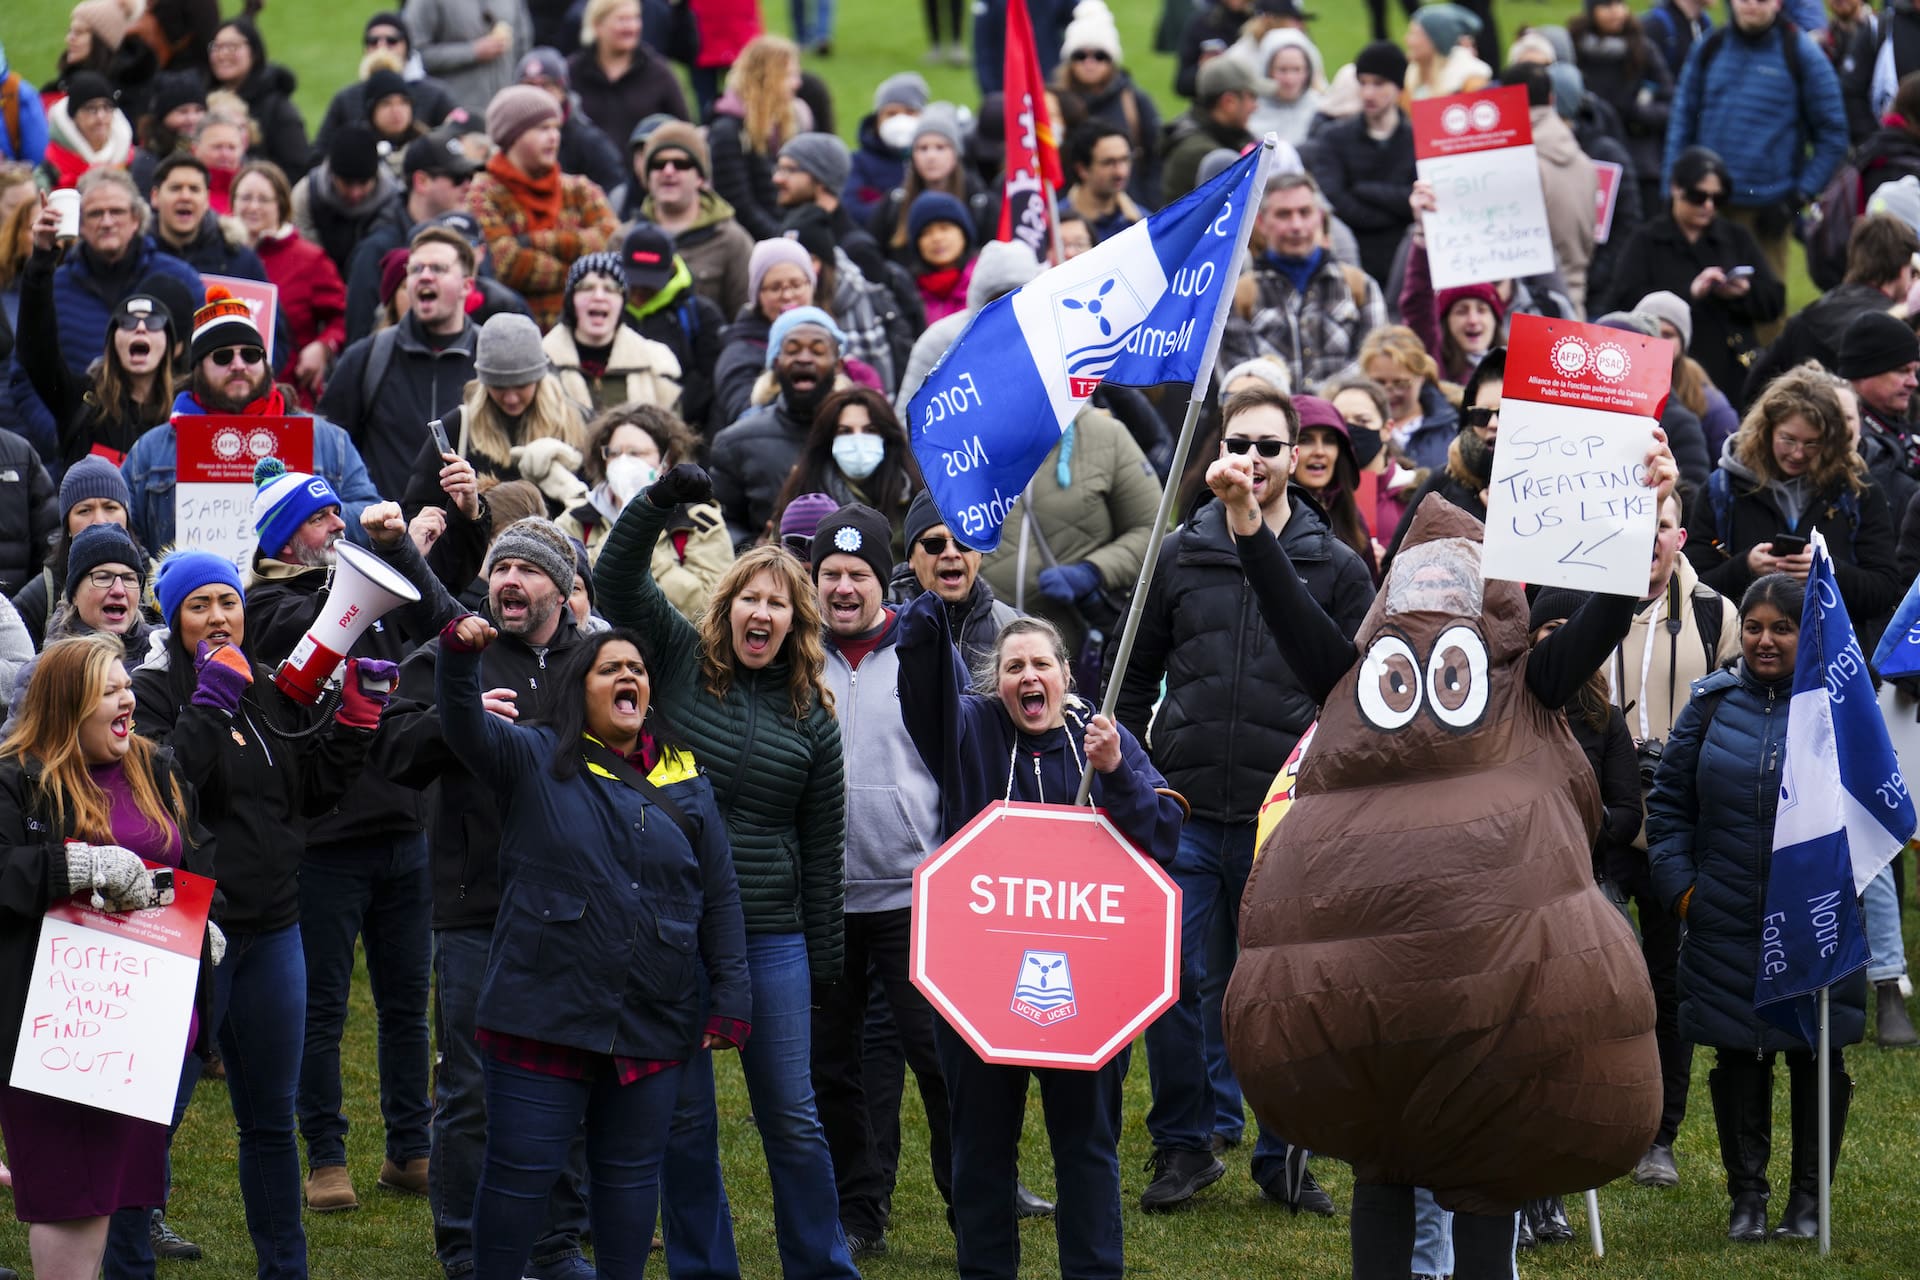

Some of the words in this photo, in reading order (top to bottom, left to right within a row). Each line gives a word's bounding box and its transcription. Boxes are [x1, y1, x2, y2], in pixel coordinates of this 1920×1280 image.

[1560, 352, 1584, 363] AFPC
[1599, 357, 1622, 369] PSAC
[1528, 375, 1551, 386] Alliance
[1552, 379, 1560, 387] de
[1560, 380, 1566, 388] la
[1567, 381, 1591, 391] Fonction
[1592, 385, 1617, 395] publique
[1617, 388, 1625, 396] du
[1626, 389, 1648, 399] Canada
[1541, 387, 1558, 396] Public
[1560, 389, 1580, 399] Service
[1580, 392, 1603, 403] Alliance
[1604, 395, 1611, 403] of
[1611, 397, 1634, 407] Canada
[219, 440, 239, 450] AFPC
[251, 440, 271, 449] PSAC
[1509, 425, 1605, 460] STOP
[1512, 506, 1563, 536] US
[1581, 495, 1654, 521] LIKE
[186, 526, 227, 544] MON
[968, 874, 1125, 924] STRIKE
[161, 925, 181, 938] Canada
[1807, 890, 1842, 958] Notre
[147, 930, 167, 943] Canada
[1762, 911, 1789, 981] Force,
[51, 937, 164, 978] Fortier
[66, 995, 128, 1020] AND
[1016, 1002, 1042, 1020] UCTE
[1047, 1006, 1072, 1021] UCET
